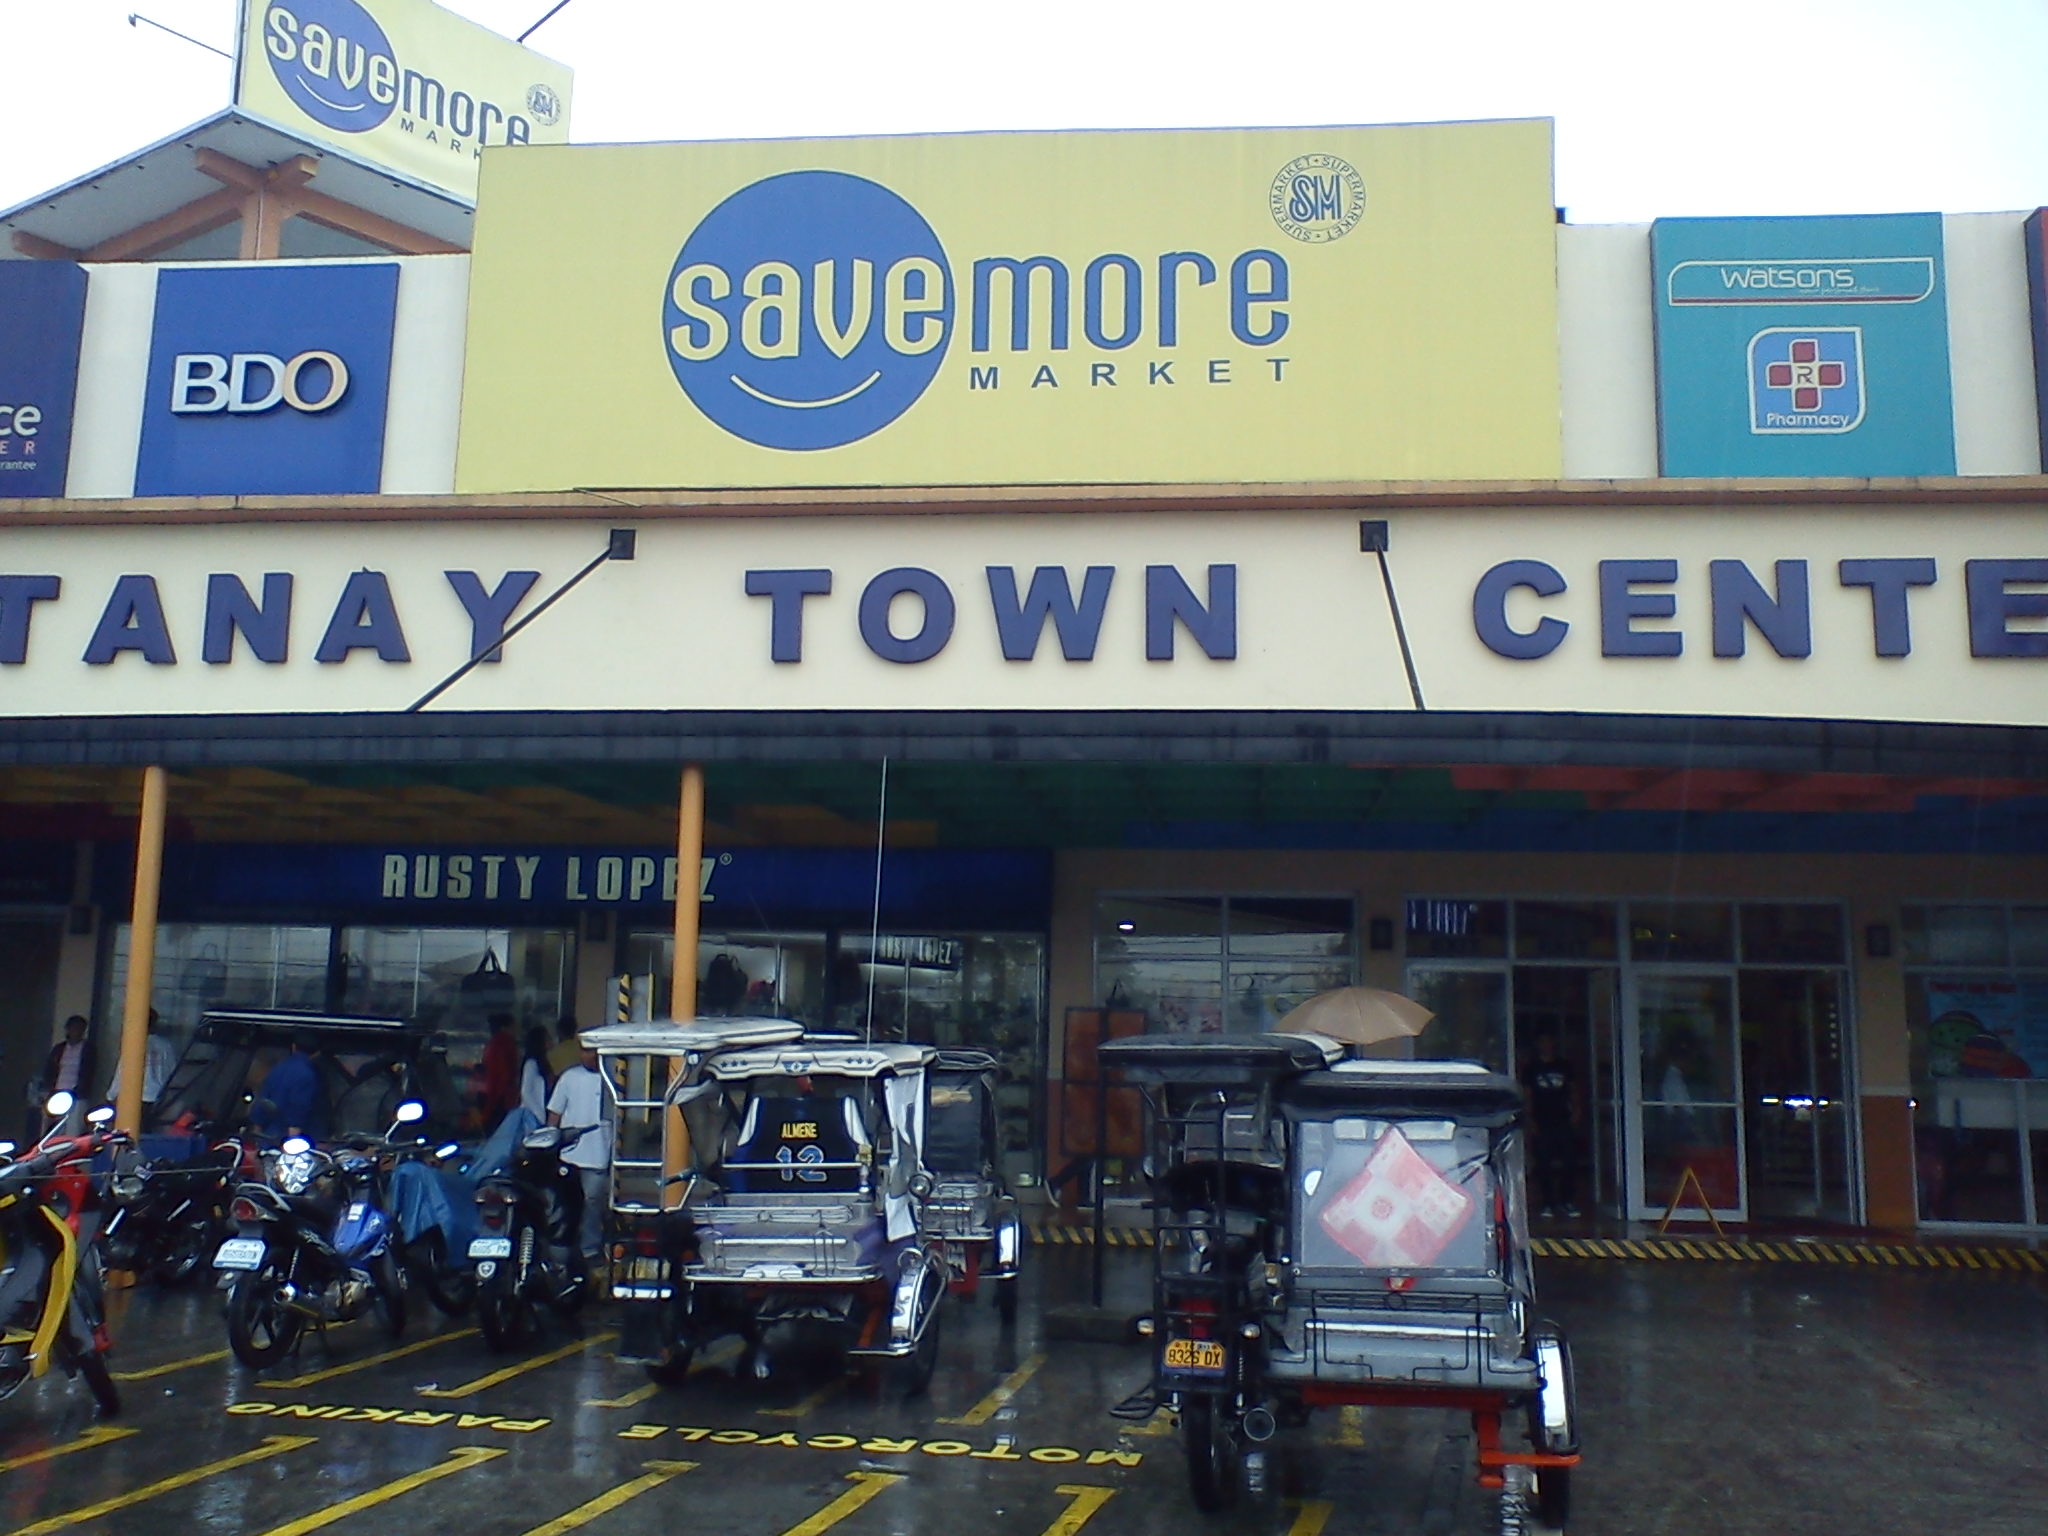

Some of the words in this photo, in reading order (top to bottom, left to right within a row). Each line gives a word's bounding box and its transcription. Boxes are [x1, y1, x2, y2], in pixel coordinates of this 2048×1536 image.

[1288, 174, 1342, 223] SM
[1720, 266, 1855, 289] Watsons
[171, 351, 350, 415] BDO
[969, 358, 1291, 390] MARKET
[1766, 412, 1850, 426] Pharmacy
[0, 568, 541, 664] TANAY
[744, 563, 1238, 664] TOWN
[382, 854, 541, 899] RUSTY
[775, 1144, 828, 1182] 12
[225, 1402, 552, 1432] PARKING
[618, 1425, 1143, 1467] MOTORCYCLE
